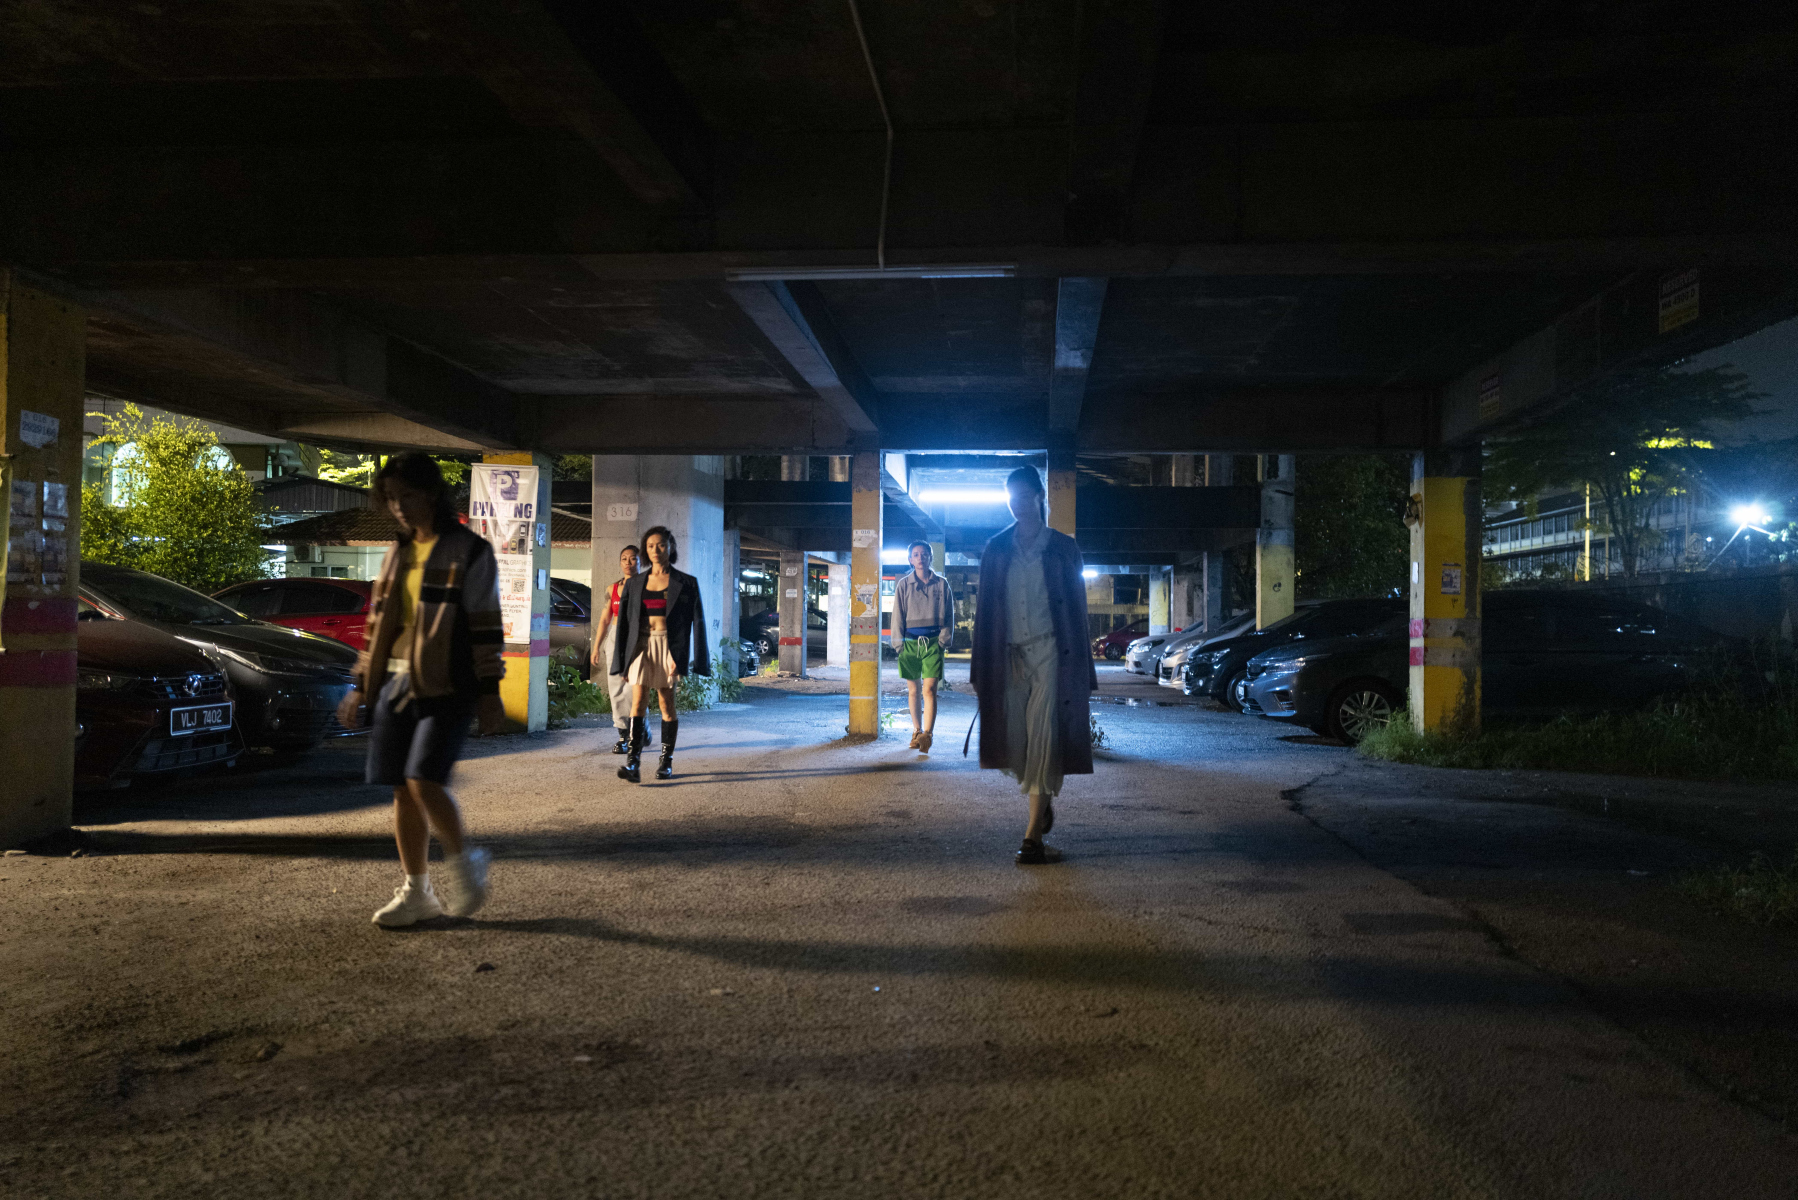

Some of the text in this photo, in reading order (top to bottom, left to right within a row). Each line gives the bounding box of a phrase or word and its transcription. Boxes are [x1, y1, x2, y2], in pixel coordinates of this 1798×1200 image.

[472, 501, 533, 519] PARNG
[610, 506, 632, 517] 316
[181, 709, 222, 728] VLJ 7402
